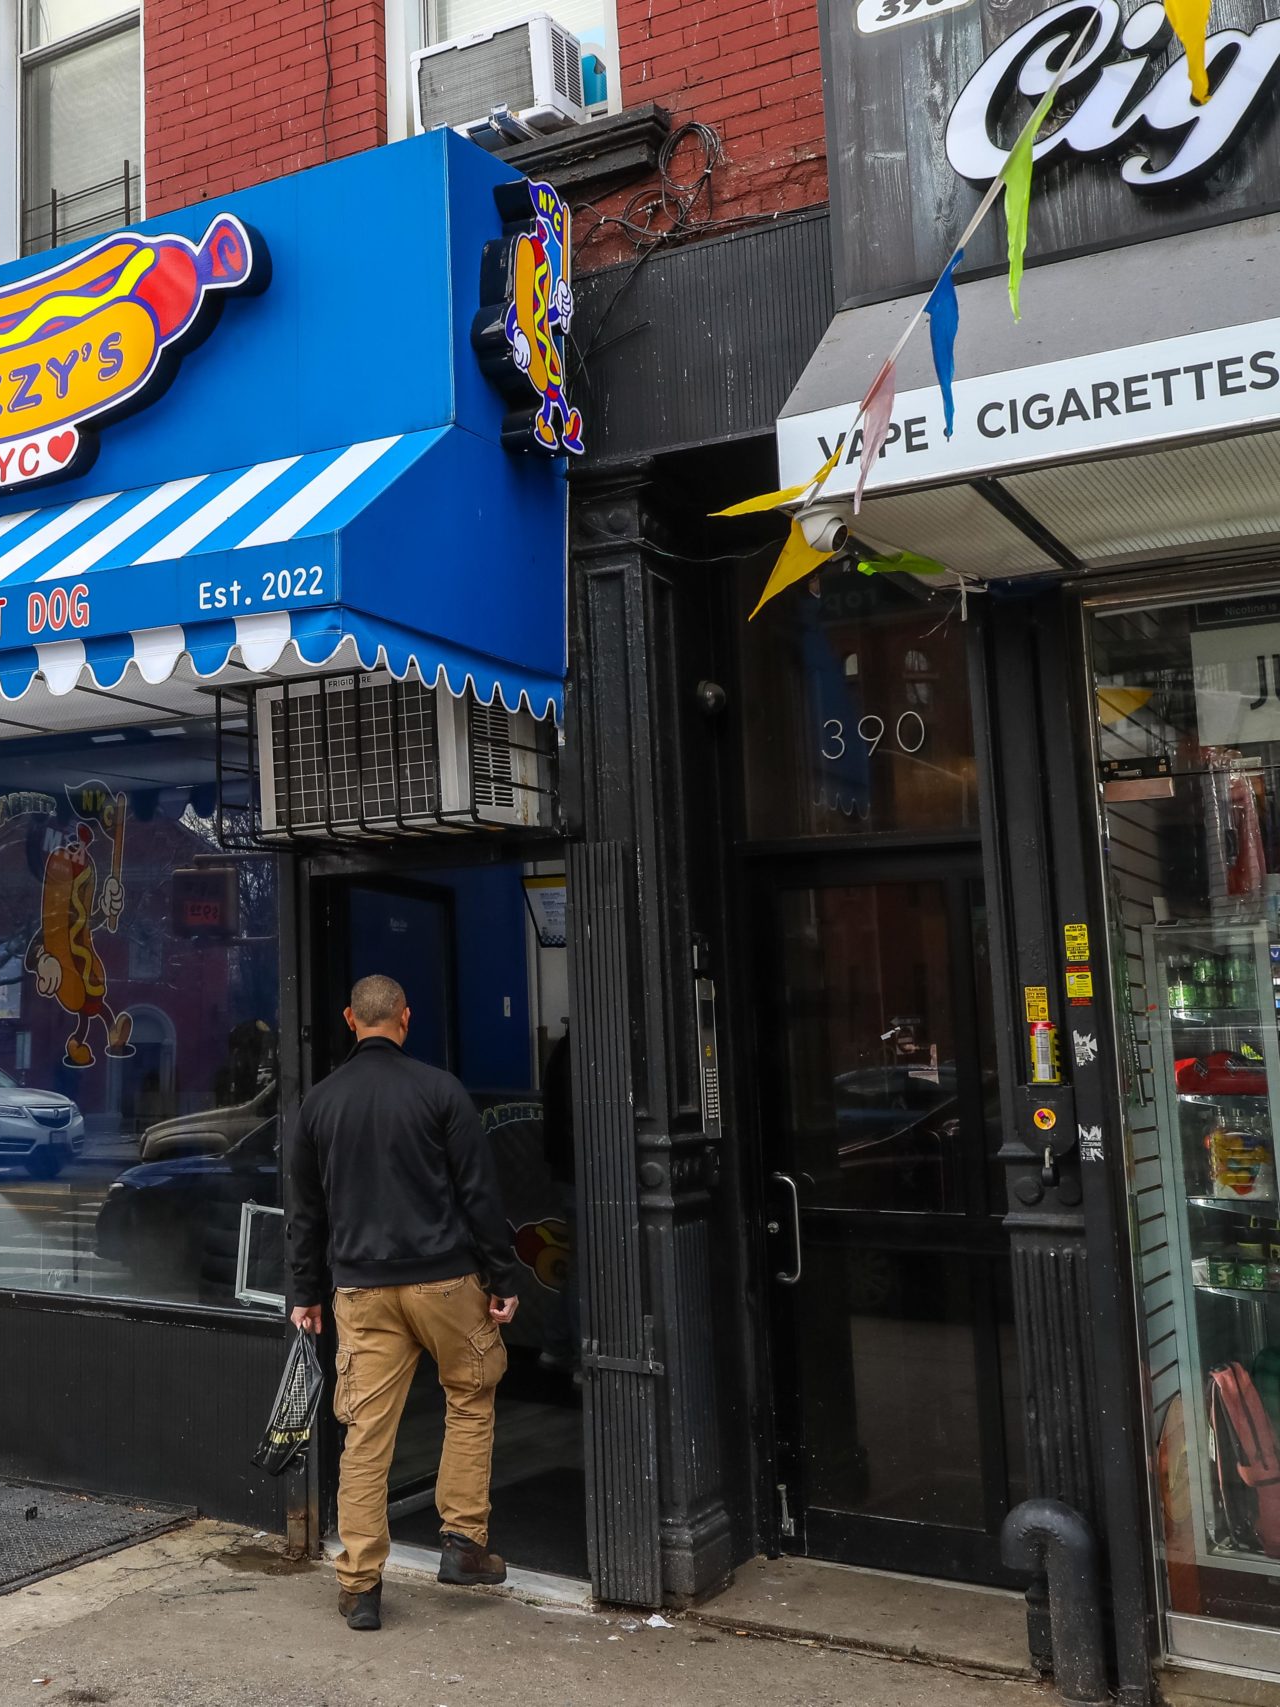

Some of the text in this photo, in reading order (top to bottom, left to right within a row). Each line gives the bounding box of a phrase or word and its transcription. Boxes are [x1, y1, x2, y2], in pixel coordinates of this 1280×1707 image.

[538, 188, 562, 232] NYC
[817, 351, 1280, 467] VAPE CIGARETTES
[27, 583, 91, 634] DOG
[198, 565, 324, 611] Est. 2022
[328, 675, 373, 688] FRIGIDRE
[821, 710, 925, 760] 390
[82, 789, 115, 827] NYC
